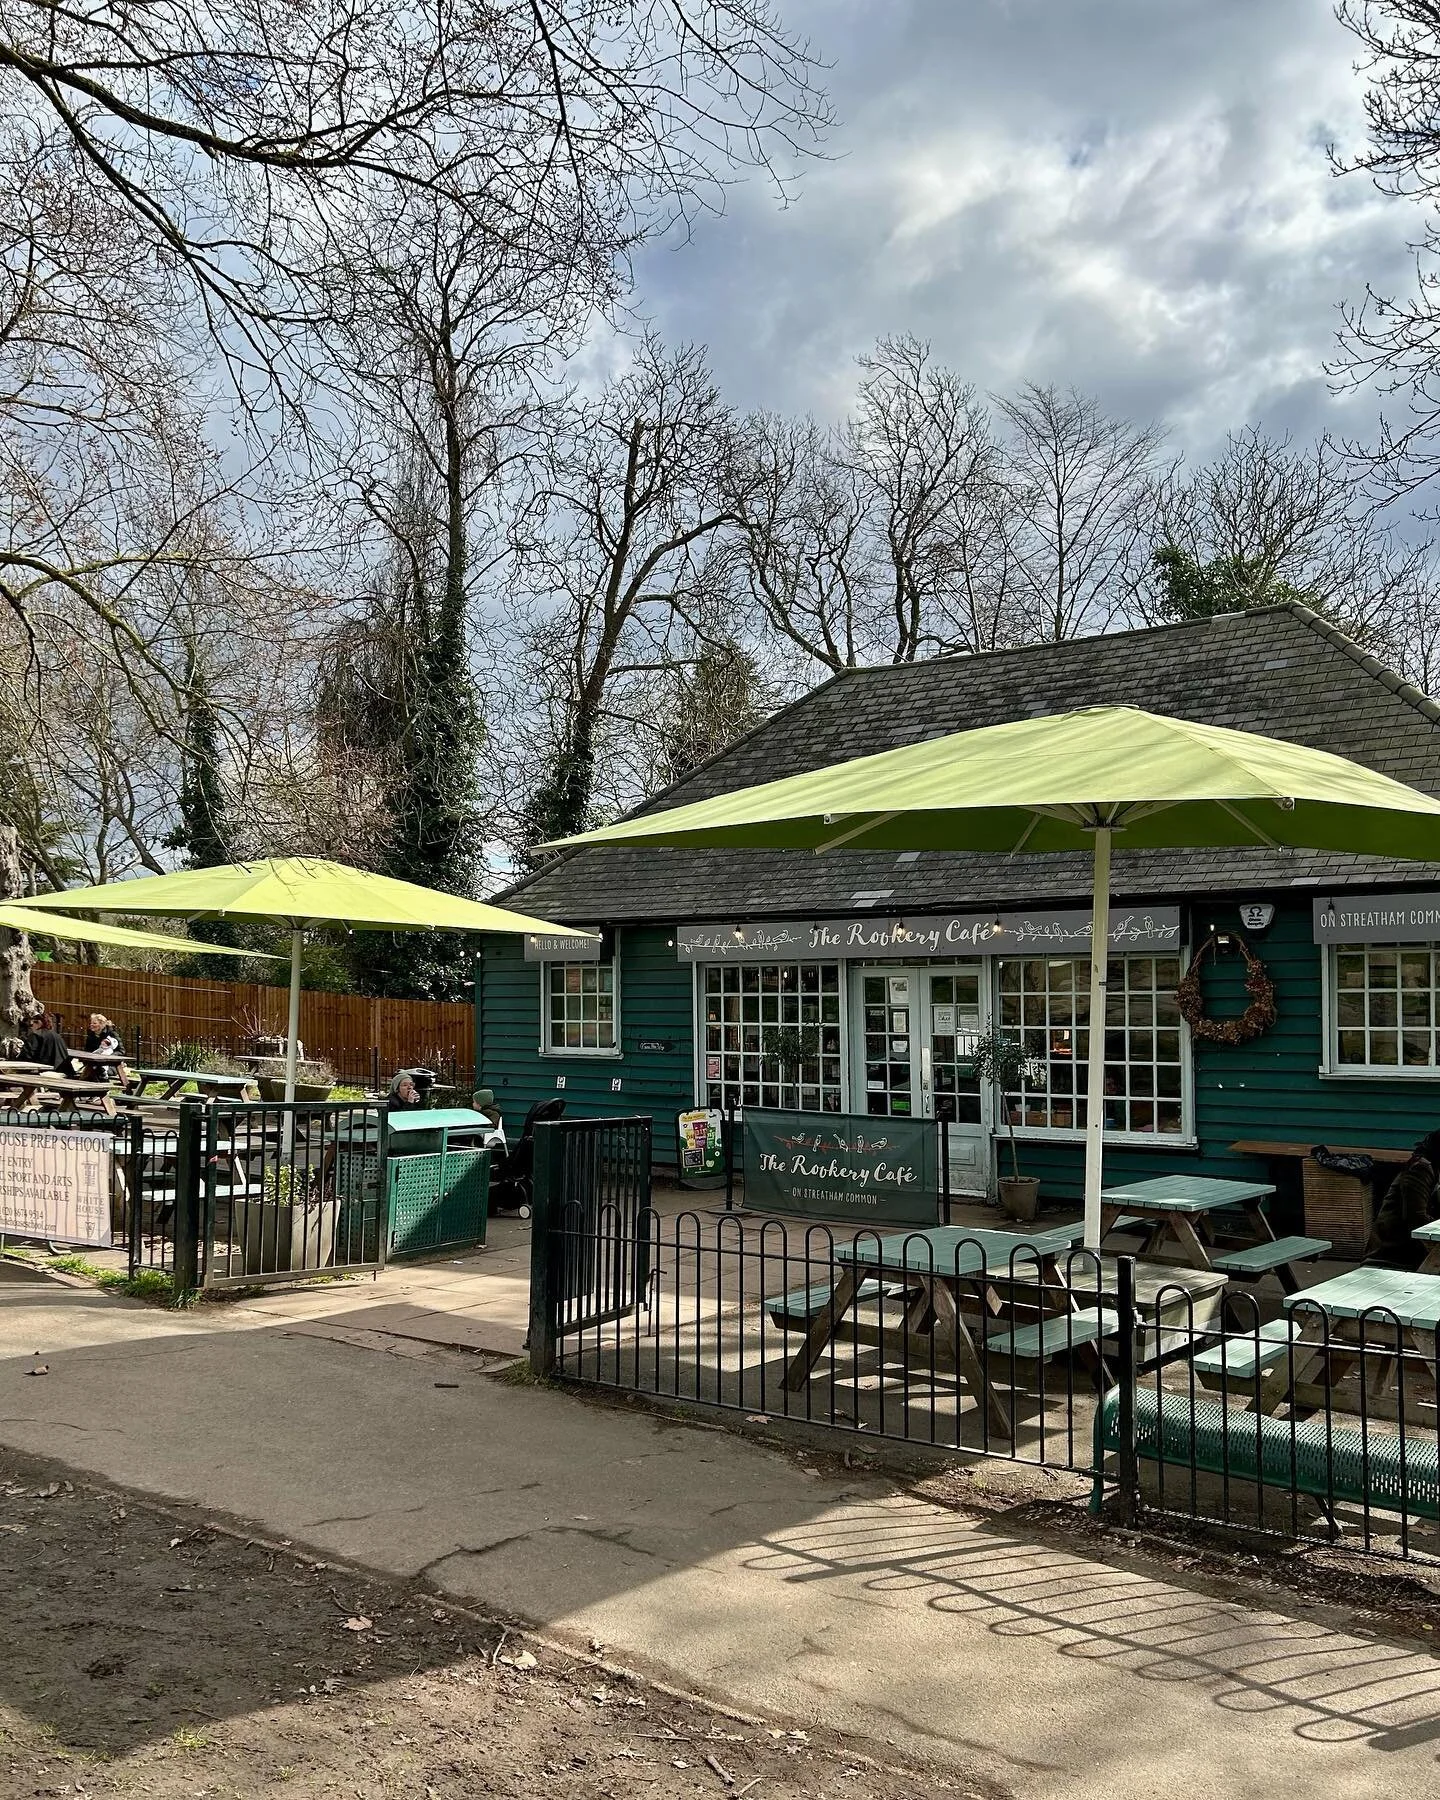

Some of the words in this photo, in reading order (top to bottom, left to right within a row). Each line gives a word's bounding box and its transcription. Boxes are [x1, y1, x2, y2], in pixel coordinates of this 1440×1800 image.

[1320, 913, 1336, 928] ON
[1340, 911, 1405, 928] STREATHAM
[808, 926, 841, 949] The
[847, 922, 940, 952] Rookery
[945, 919, 996, 946] Café
[534, 939, 552, 950] HELLO
[553, 939, 558, 950] &
[30, 1133, 59, 1150] PREP
[60, 1135, 109, 1154] SCHOOL
[7, 1156, 33, 1169] ENTRY
[759, 1153, 786, 1172] The
[790, 1154, 870, 1188] Rookery
[873, 1162, 918, 1186] Café
[7, 1171, 32, 1184] SPORT
[33, 1174, 51, 1185] AND
[53, 1175, 73, 1188] ARTS
[24, 1187, 70, 1202] AVAILABLE
[792, 1186, 801, 1198] ON
[804, 1188, 843, 1202] STREATHAM
[845, 1192, 877, 1205] COMMON
